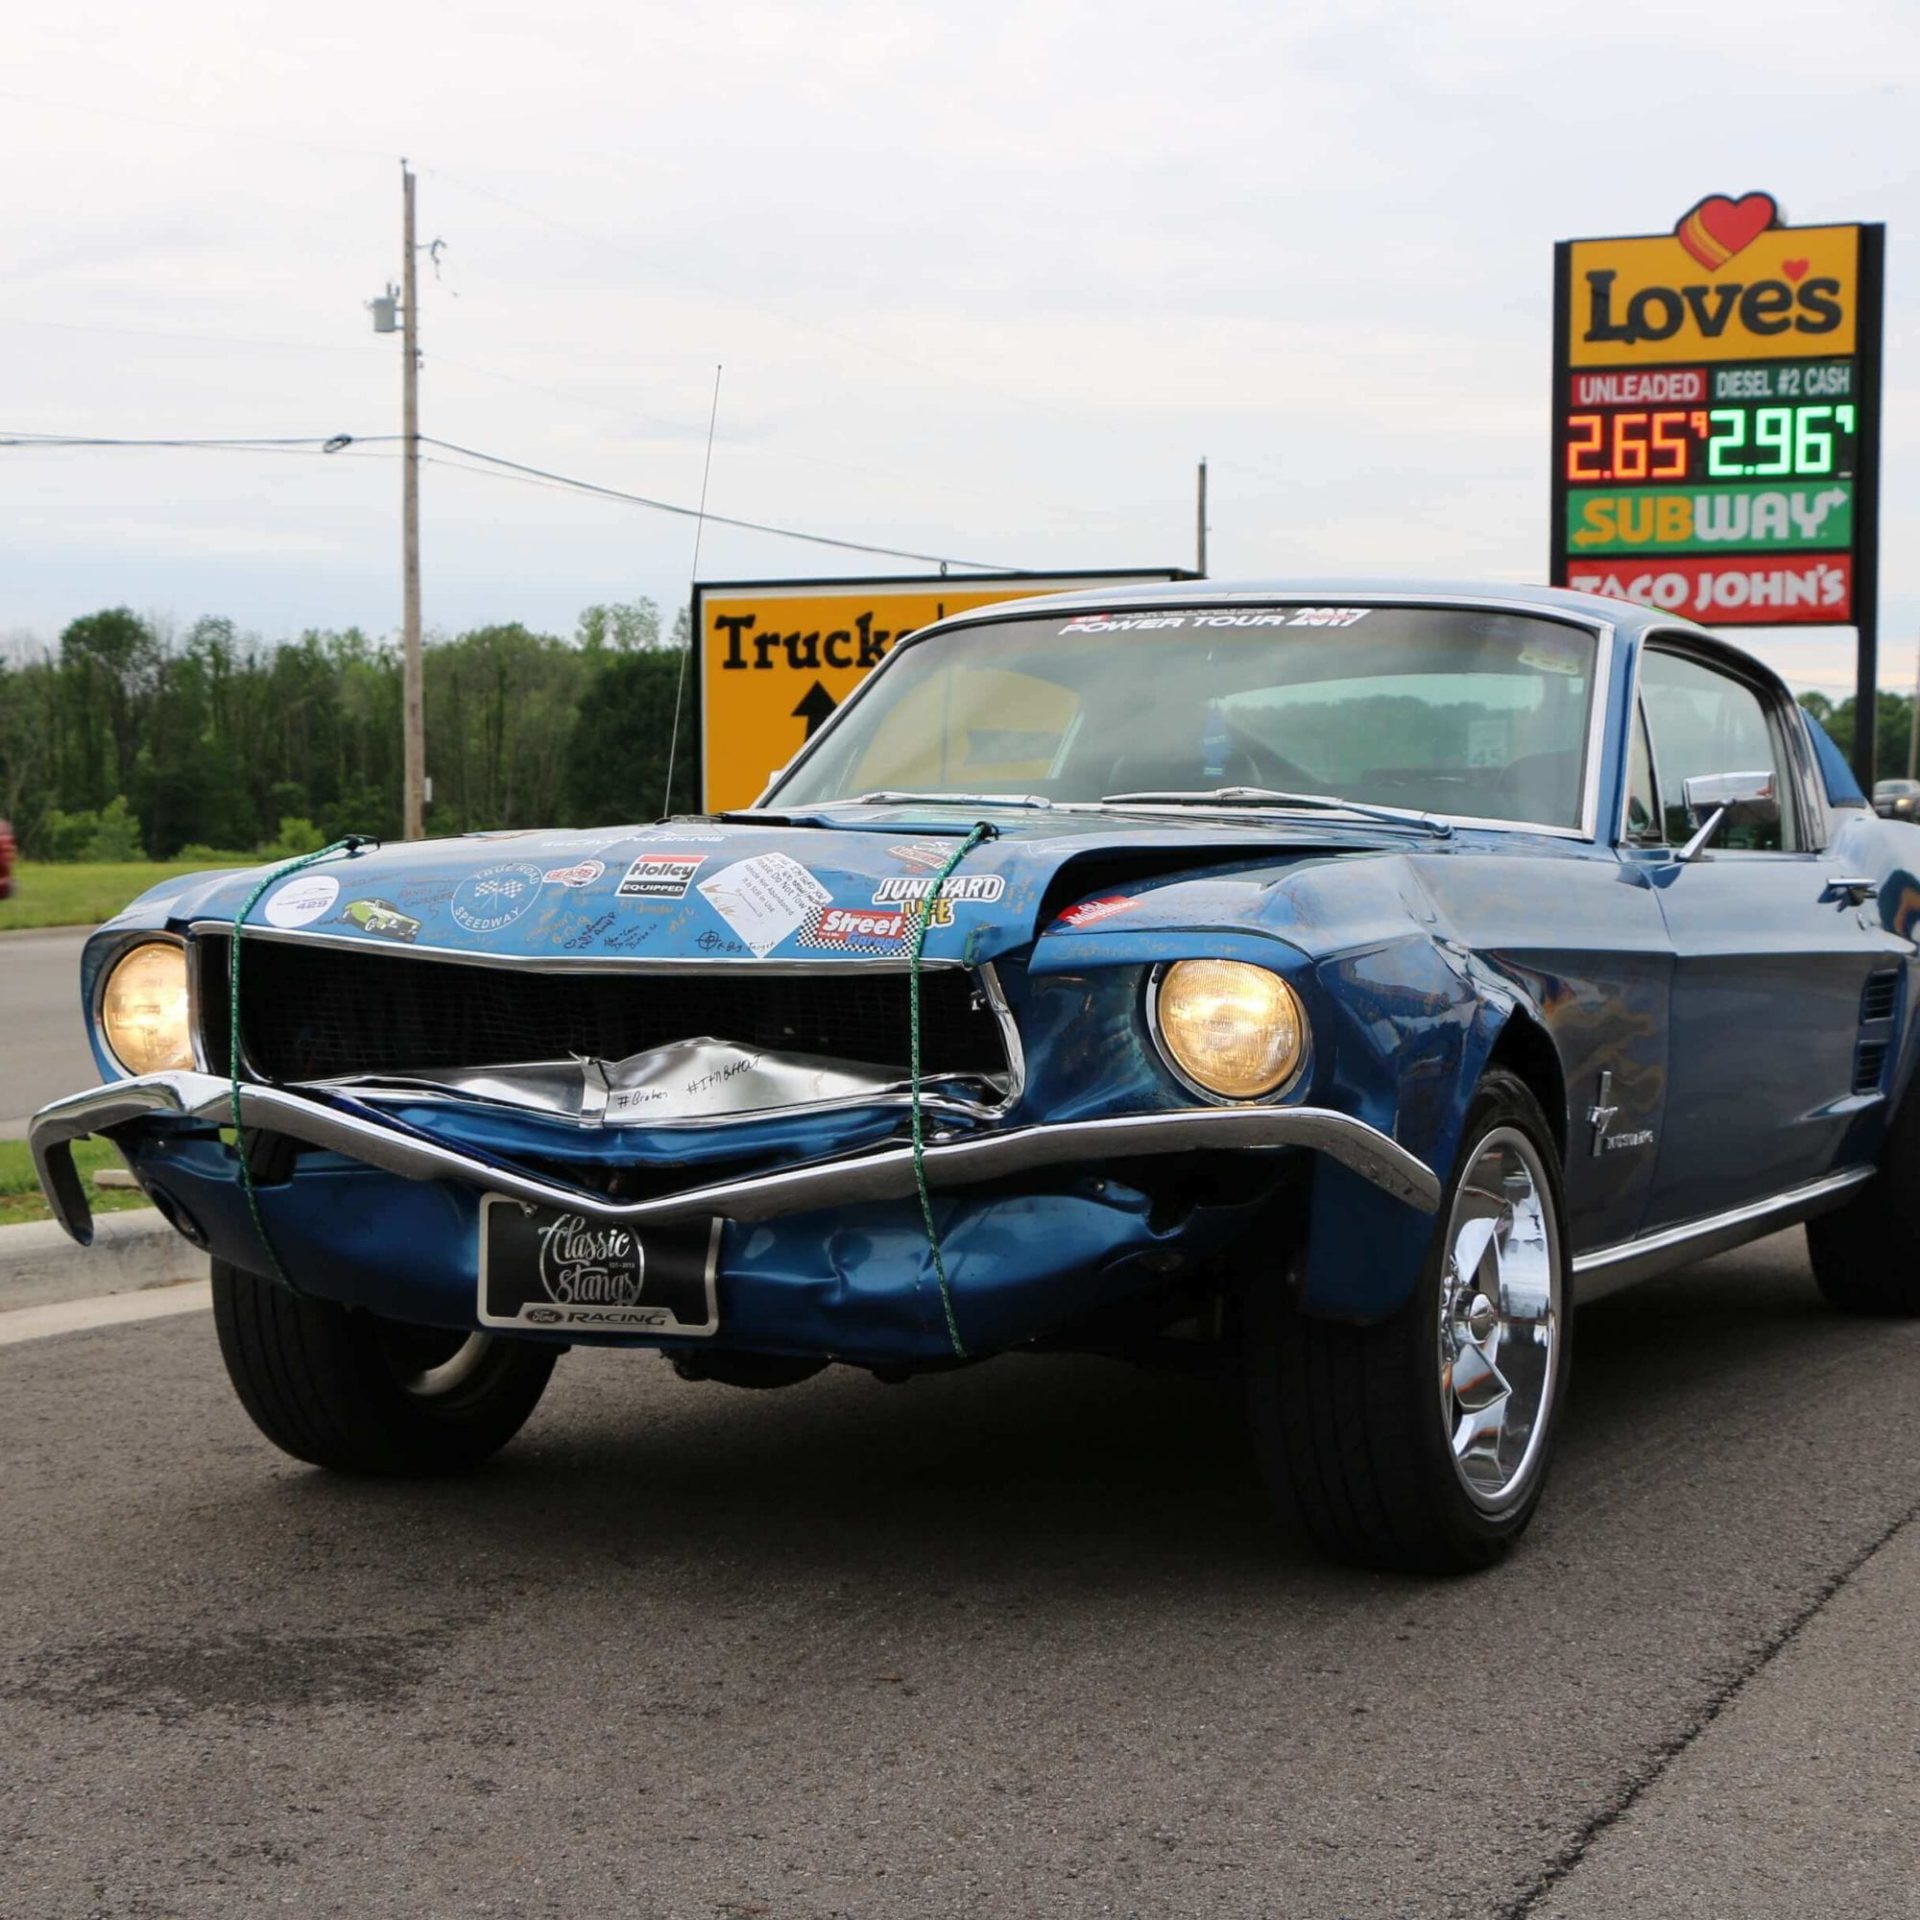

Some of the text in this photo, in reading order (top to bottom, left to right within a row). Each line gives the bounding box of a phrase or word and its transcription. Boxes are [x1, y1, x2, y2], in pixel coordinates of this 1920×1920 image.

[1580, 373, 1699, 403] UNLEADED
[1716, 367, 1850, 398] DIESEL #2 CASH
[1572, 488, 1849, 548] SUBWAY
[1694, 564, 1846, 611] JOHN'S
[1058, 617, 1186, 635] POWER
[1192, 615, 1285, 627] TOUR
[1286, 607, 1372, 627] 2017
[629, 863, 697, 880] Holley
[770, 871, 783, 884] Do
[779, 880, 795, 896] Not
[622, 884, 684, 892] EQUIPPED
[455, 906, 520, 929] SPEEDWAY
[823, 910, 901, 936] Street
[538, 1214, 631, 1266] Classic
[556, 1264, 638, 1306] Stangs
[567, 1312, 667, 1326] RACING
